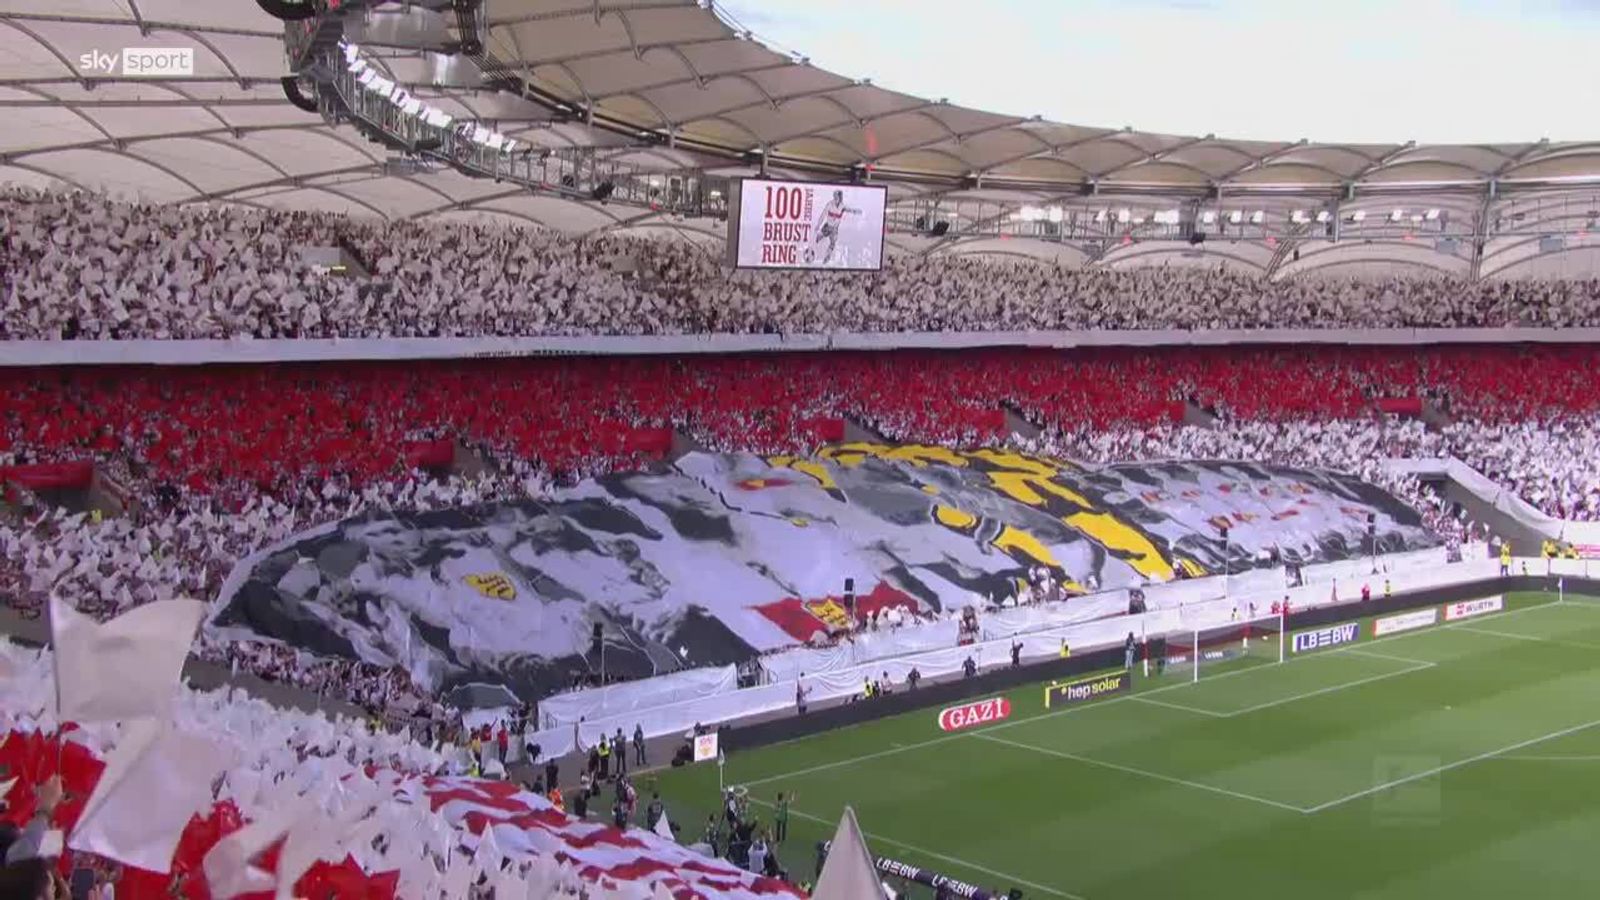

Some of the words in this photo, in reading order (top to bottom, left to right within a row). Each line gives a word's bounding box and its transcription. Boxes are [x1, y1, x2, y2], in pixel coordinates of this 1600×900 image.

[764, 186, 802, 220] 100
[762, 222, 811, 242] BRUST
[761, 244, 797, 264] RING
[1091, 678, 1121, 694] solar
[950, 697, 1004, 729] GAZI
